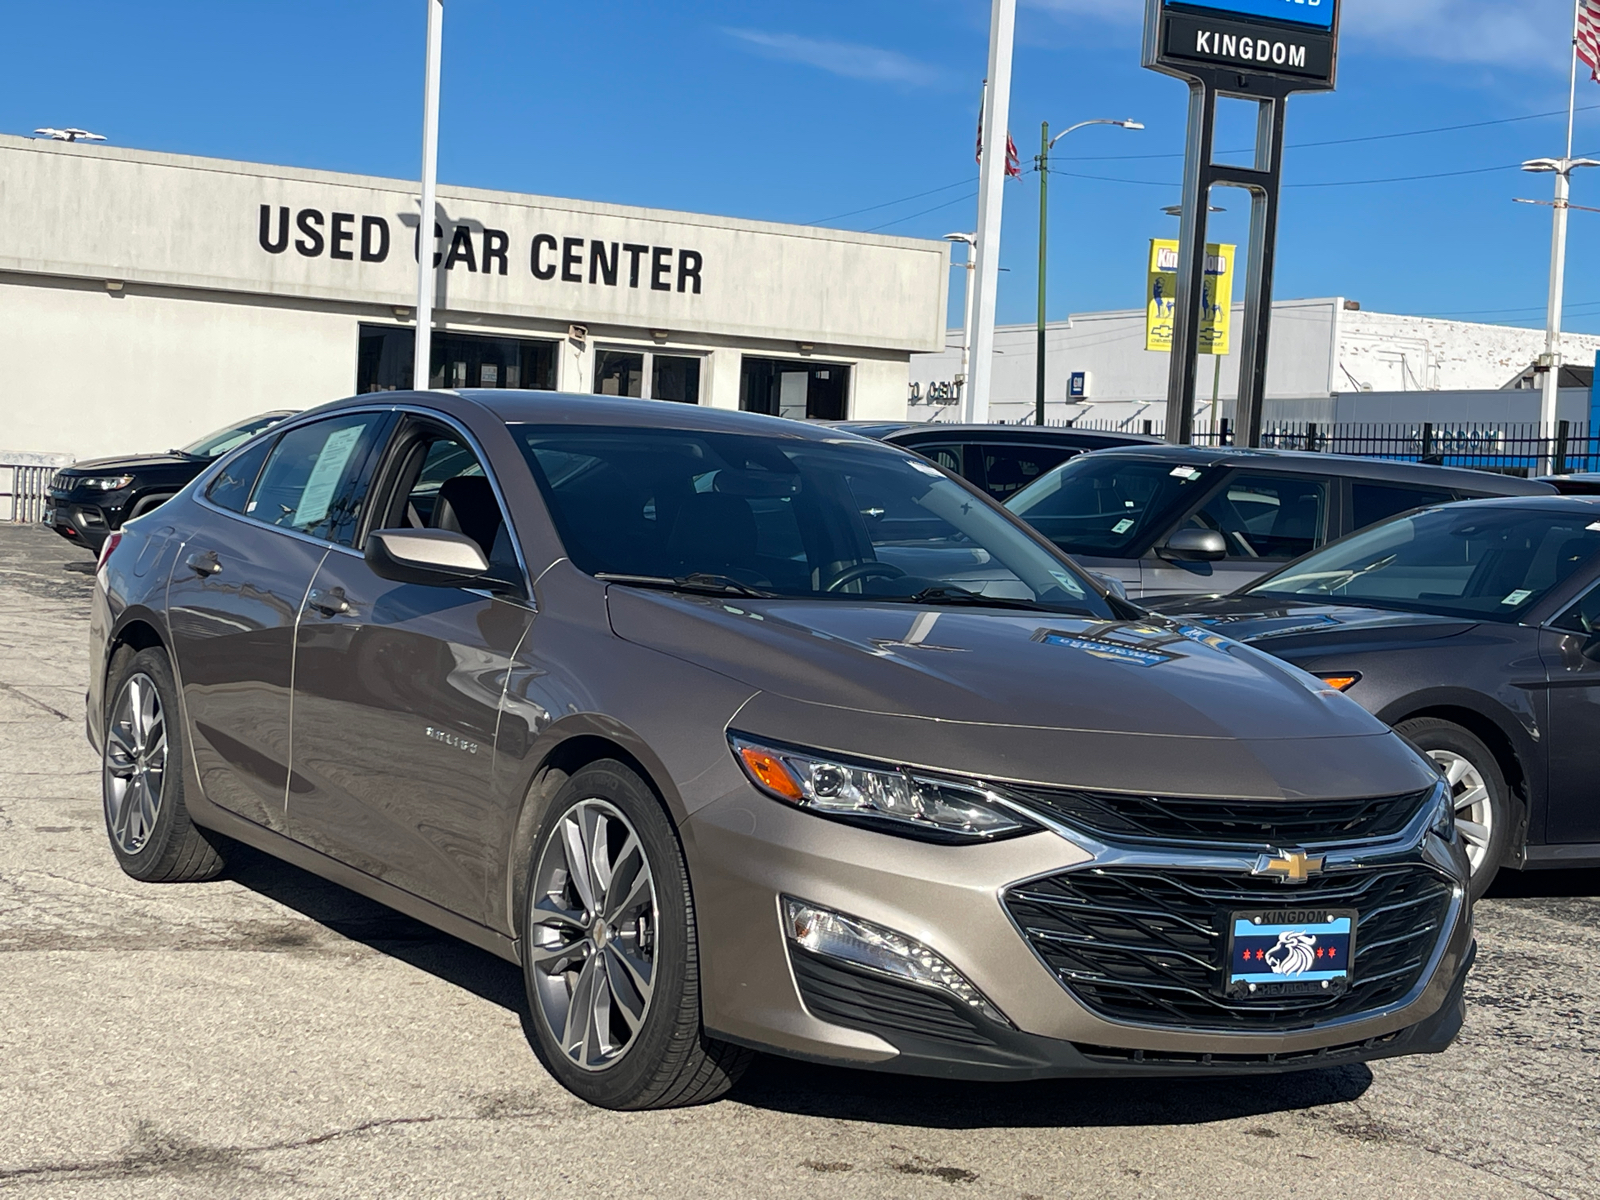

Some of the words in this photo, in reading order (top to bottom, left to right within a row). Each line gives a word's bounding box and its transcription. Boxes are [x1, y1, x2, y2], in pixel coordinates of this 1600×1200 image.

[1196, 30, 1306, 68] KINGDOM
[259, 204, 390, 263] USED
[415, 222, 509, 276] CAR
[530, 233, 703, 294] CENTER
[1262, 911, 1328, 924] KINGDOM
